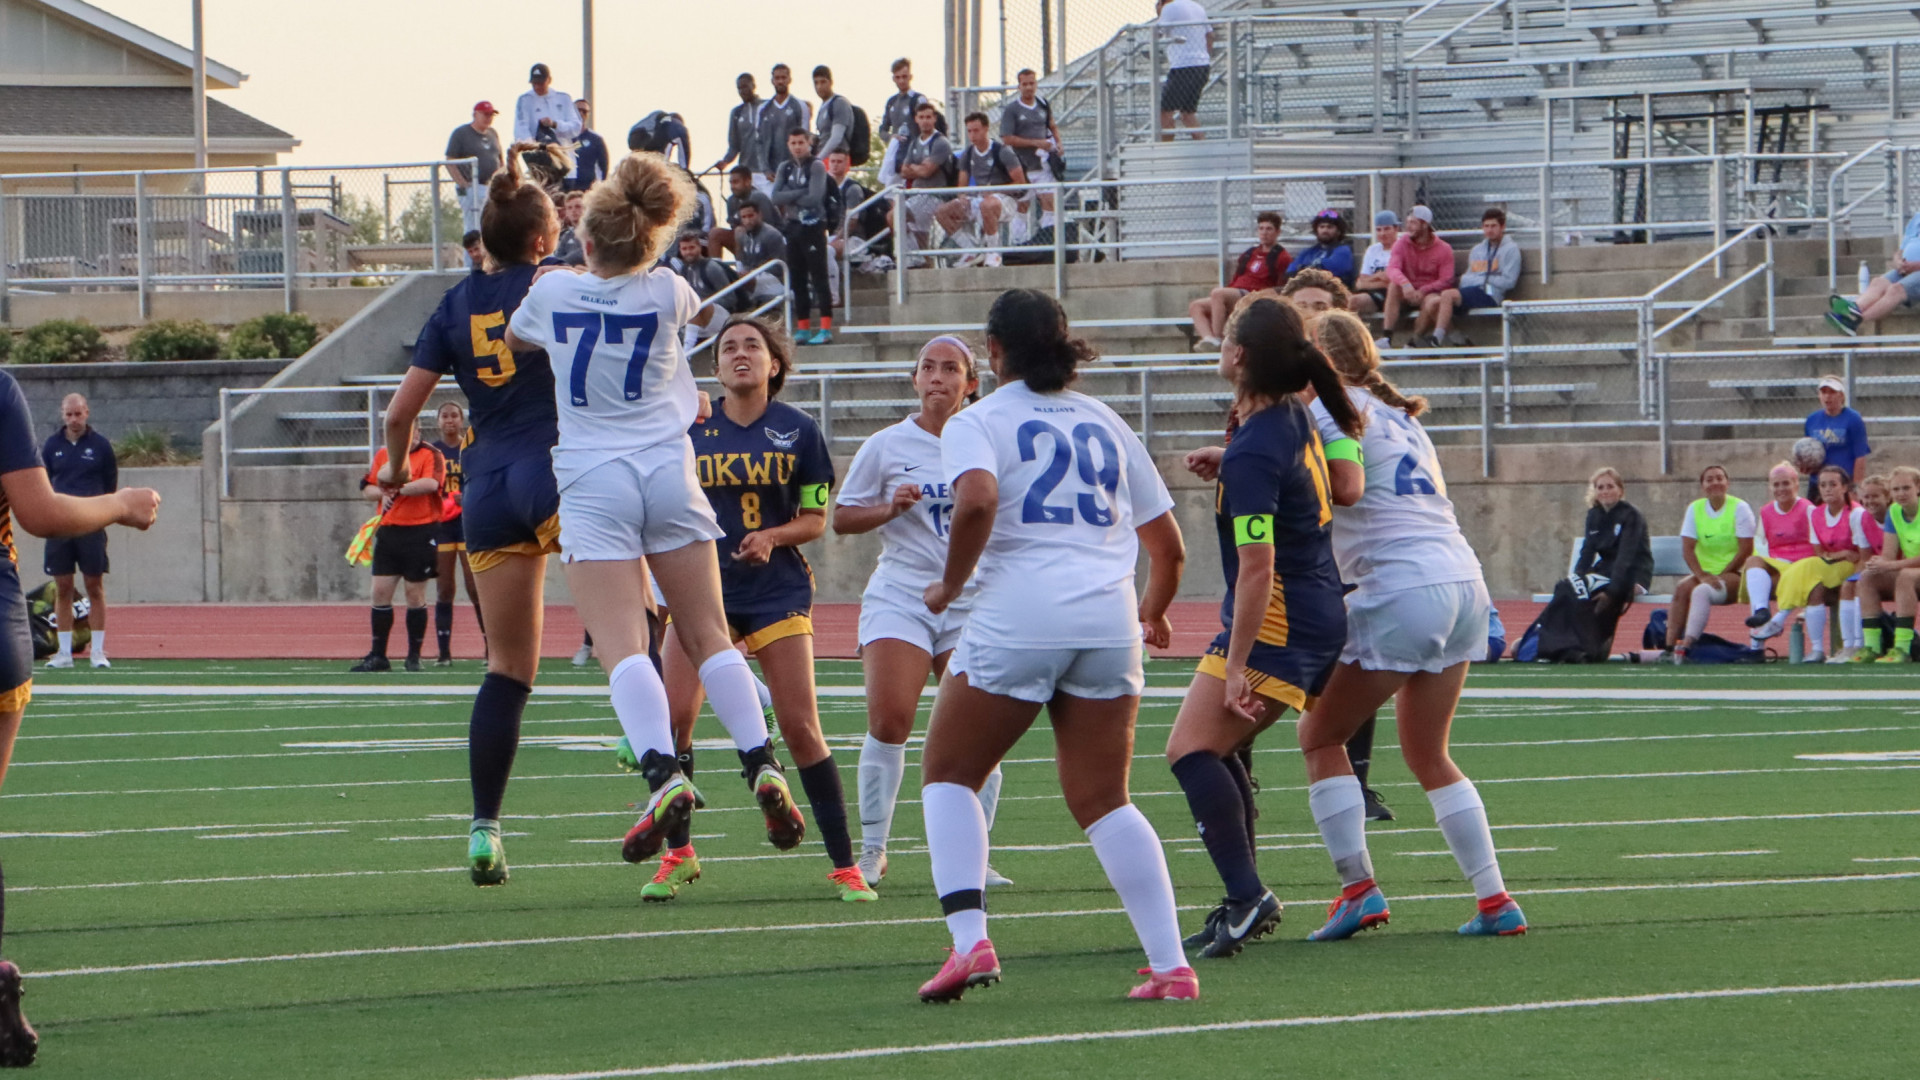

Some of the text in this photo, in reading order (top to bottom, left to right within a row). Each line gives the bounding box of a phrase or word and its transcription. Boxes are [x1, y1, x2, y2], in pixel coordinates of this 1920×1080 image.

[581, 295, 618, 306] BLUEJAYS
[470, 309, 516, 387] 5
[552, 311, 658, 407] 77
[696, 451, 796, 488] OKWU
[1017, 419, 1120, 527] 29
[740, 491, 762, 530] 8
[815, 484, 827, 506] C
[1246, 514, 1266, 541] C
